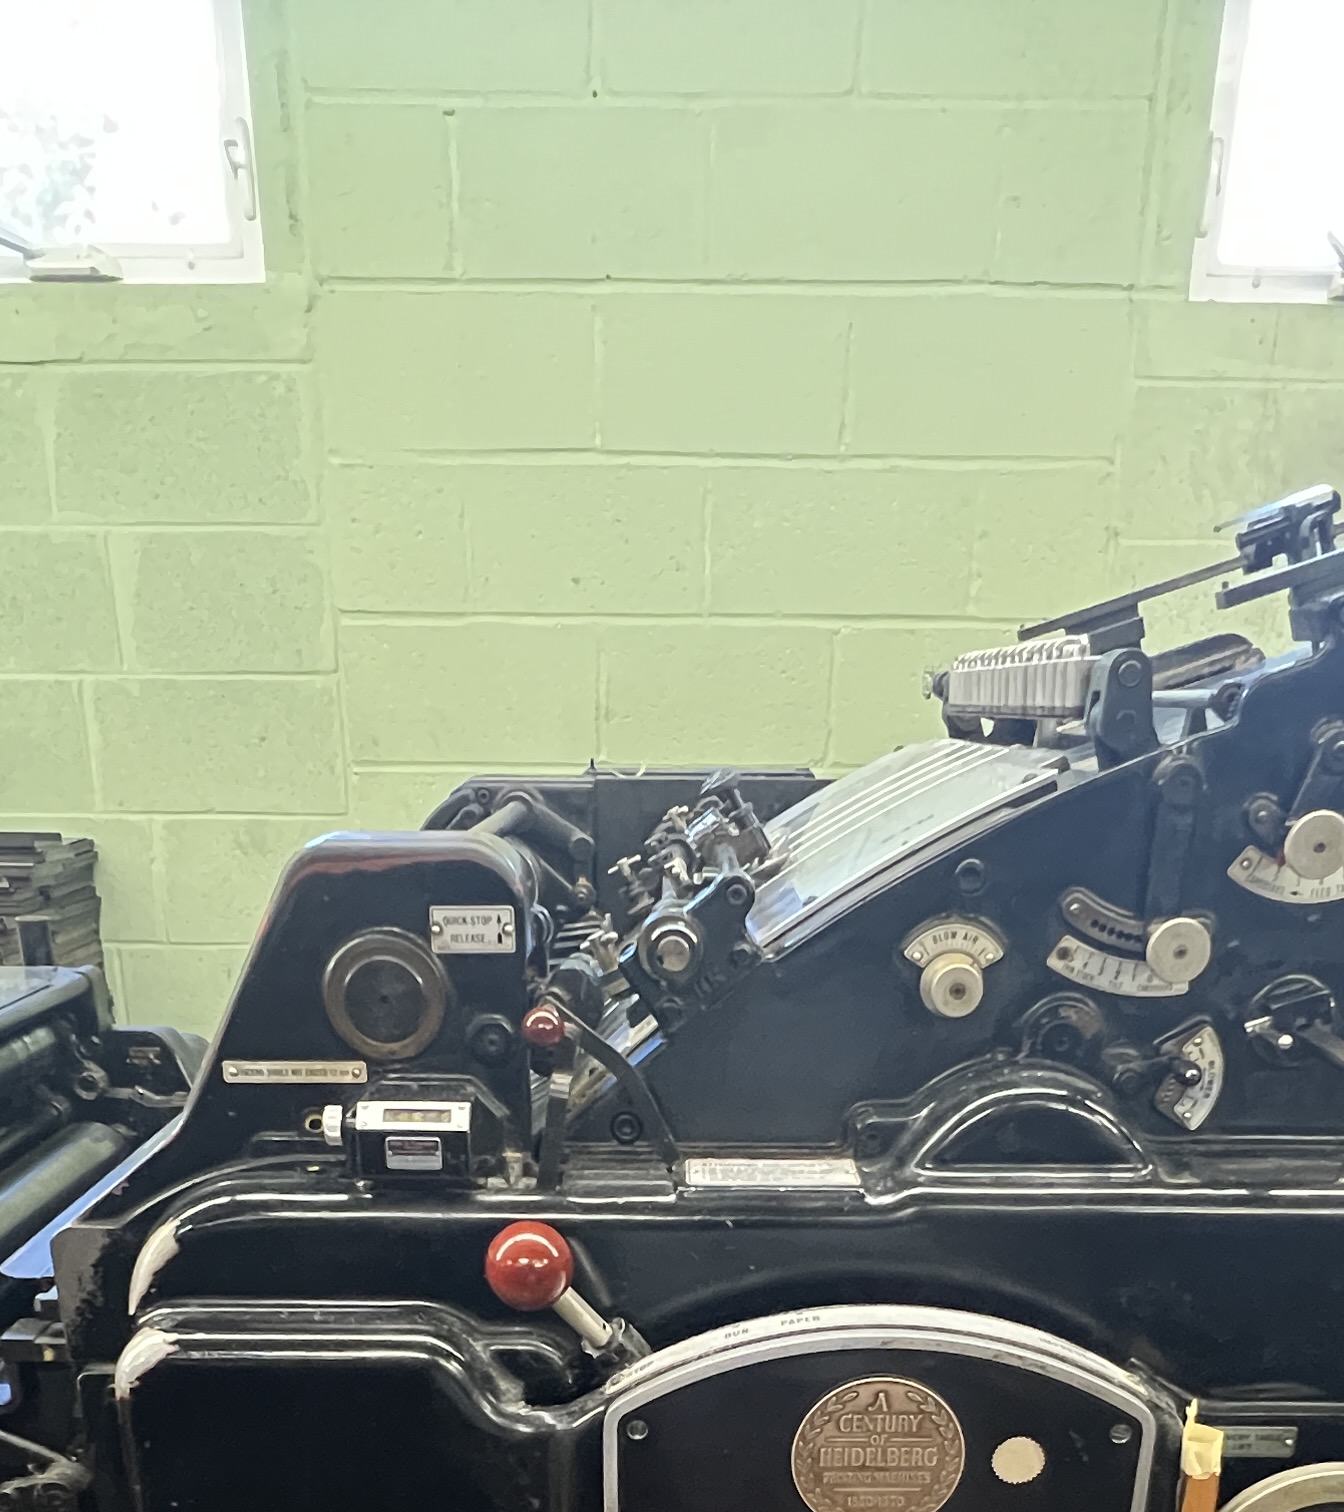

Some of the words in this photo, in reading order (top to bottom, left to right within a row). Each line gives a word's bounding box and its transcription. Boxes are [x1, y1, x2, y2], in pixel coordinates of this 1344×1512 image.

[1309, 887, 1331, 898] FEED
[442, 915, 467, 928] QUICK
[469, 915, 492, 927] STOP
[450, 933, 485, 944] RELEASE
[932, 930, 958, 945] BLOW
[962, 931, 979, 945] AIR
[780, 1315, 821, 1327] PAPER
[724, 1327, 749, 1340] RUN
[867, 1392, 889, 1412] A
[839, 1414, 924, 1433] CENTURY
[819, 1446, 939, 1468] HEIDELBERG
